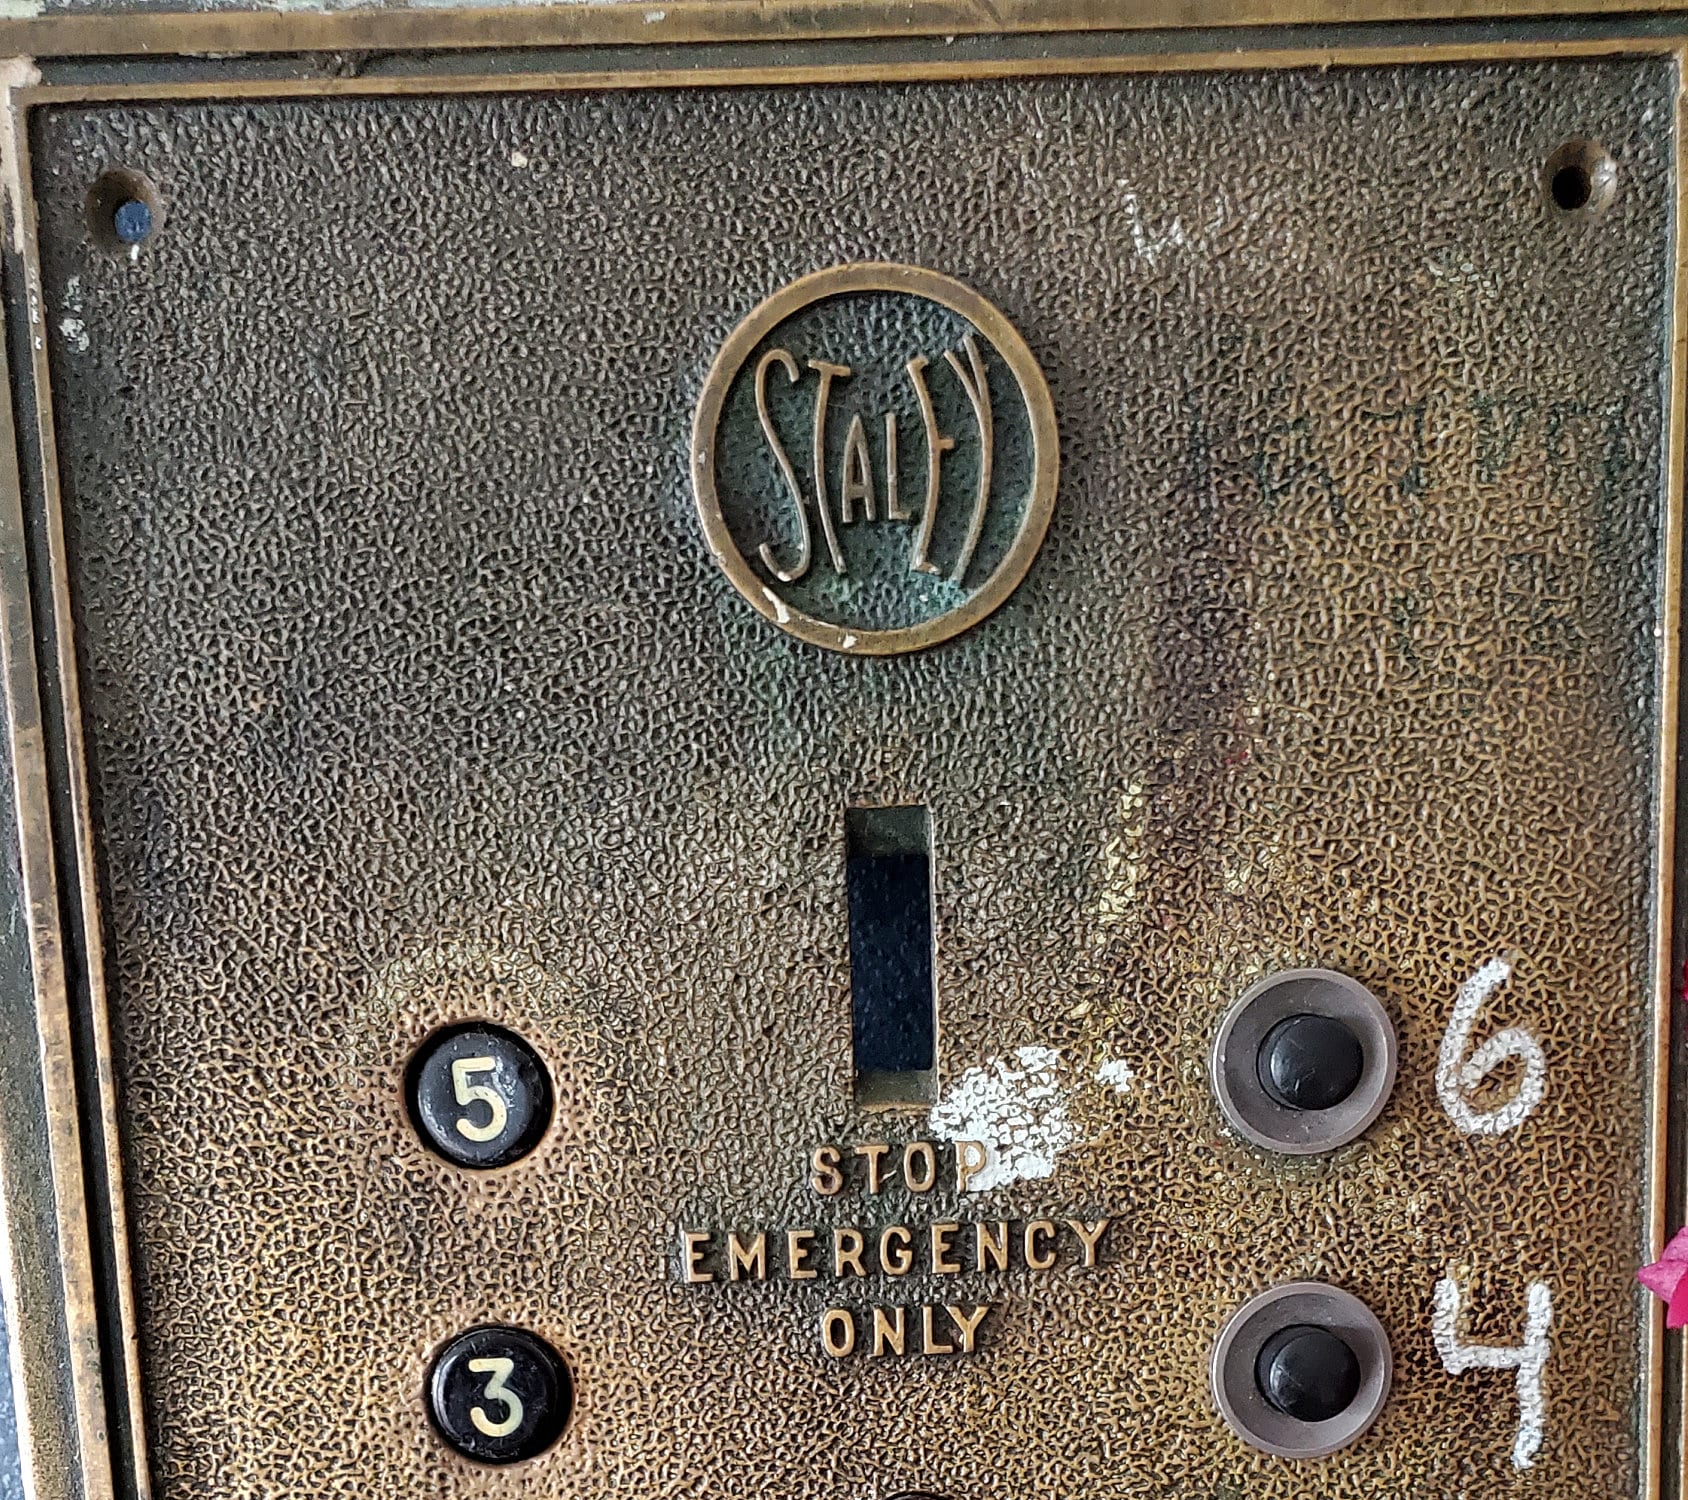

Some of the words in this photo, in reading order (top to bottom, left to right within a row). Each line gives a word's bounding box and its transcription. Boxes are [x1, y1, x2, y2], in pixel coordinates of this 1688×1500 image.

[755, 334, 993, 582] STALEY
[1435, 957, 1547, 1135] 6
[452, 1057, 506, 1142] 5
[810, 1139, 987, 1196] STOP
[682, 1217, 1111, 1283] EMERGENCY
[821, 1304, 990, 1358] ONLY
[1431, 1275, 1552, 1470] 4
[468, 1357, 524, 1438] 3
